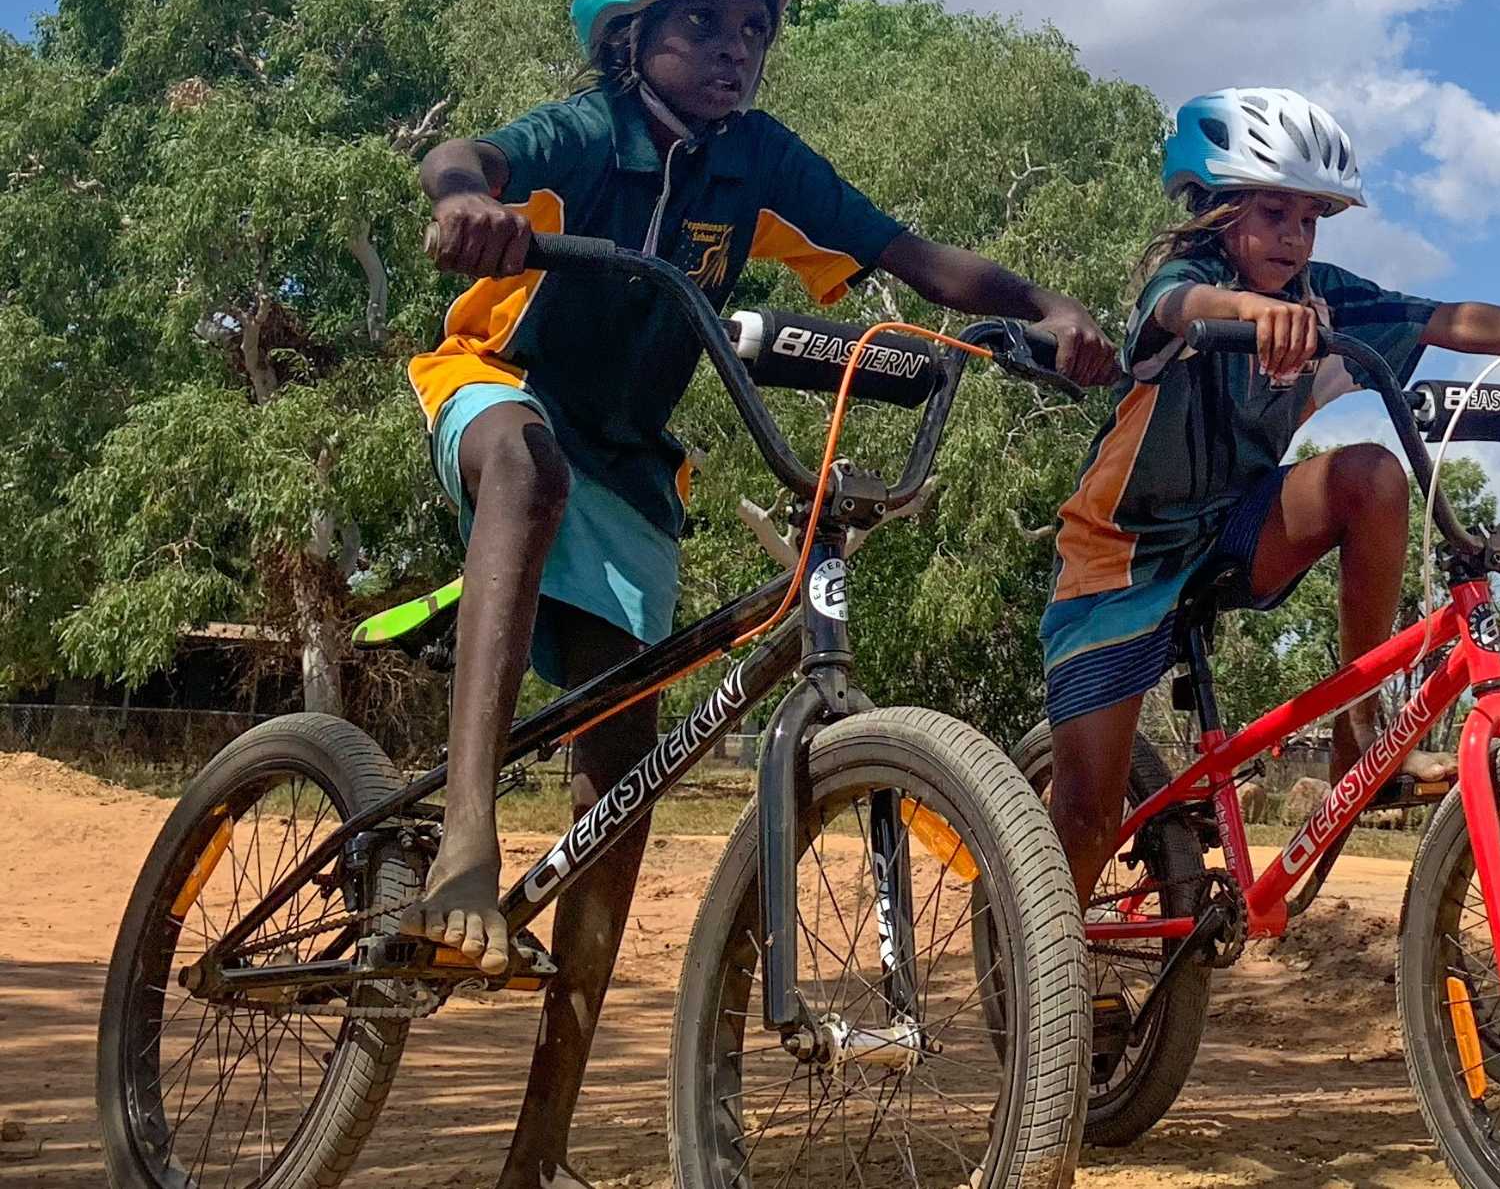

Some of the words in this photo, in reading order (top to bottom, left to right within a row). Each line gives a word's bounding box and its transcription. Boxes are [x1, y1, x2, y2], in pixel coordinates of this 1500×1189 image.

[803, 333, 926, 379] EASTERN
[568, 660, 747, 863] EASTERN
[1310, 688, 1432, 844] EASTERN
